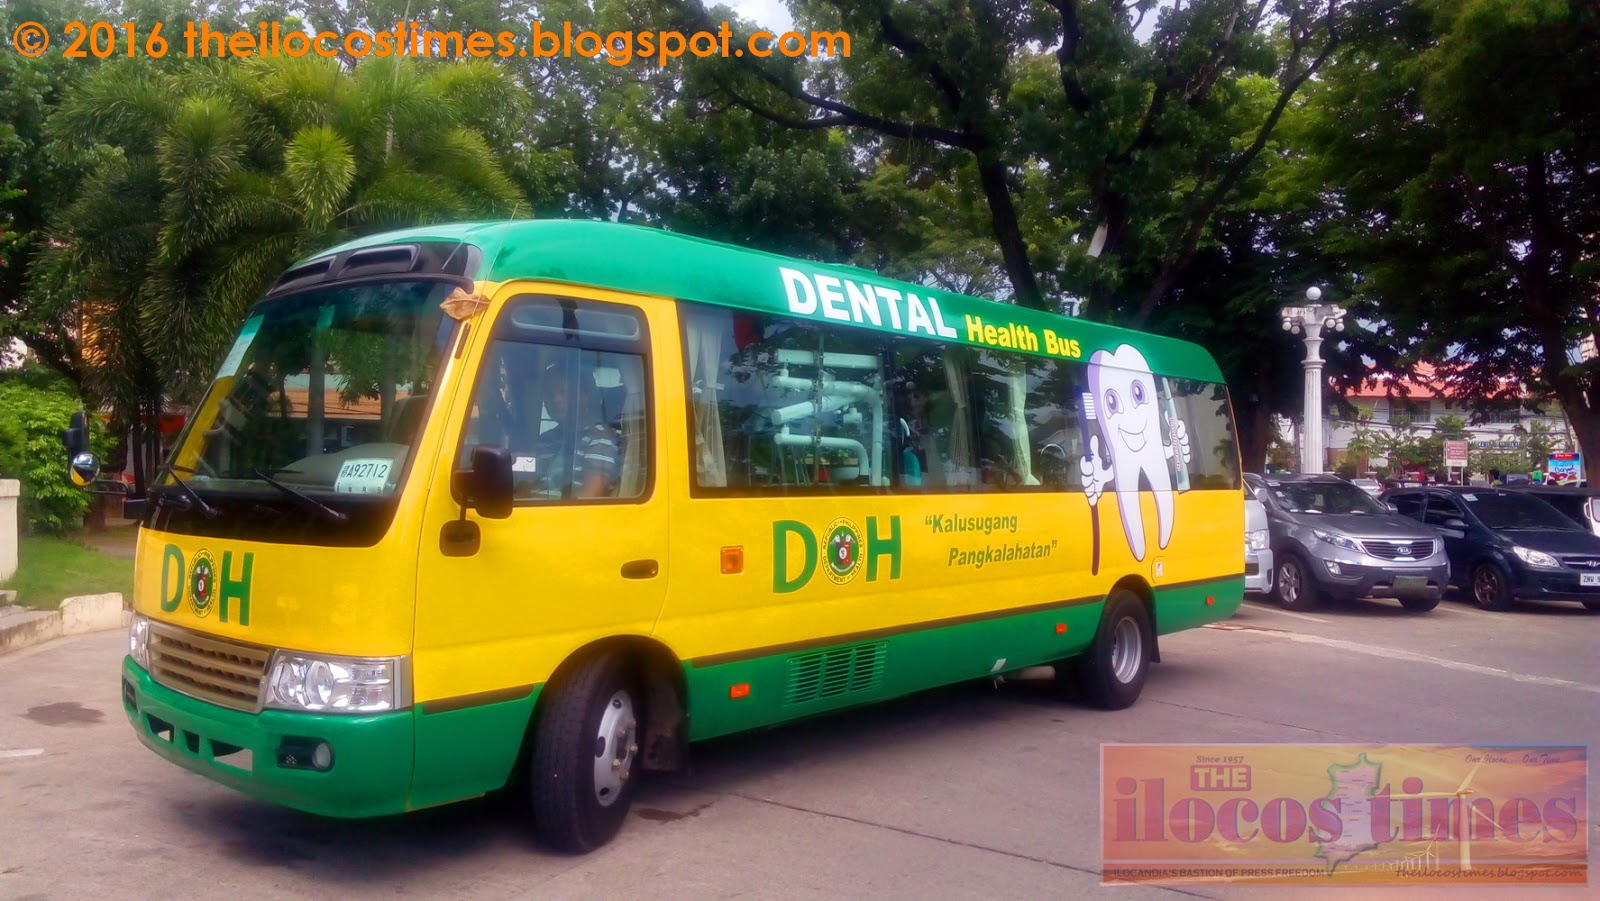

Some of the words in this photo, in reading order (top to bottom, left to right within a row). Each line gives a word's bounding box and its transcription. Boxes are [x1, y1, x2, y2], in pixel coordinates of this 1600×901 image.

[779, 266, 958, 339] DENTAL
[964, 313, 1039, 352] Health
[1043, 327, 1082, 359] Bus
